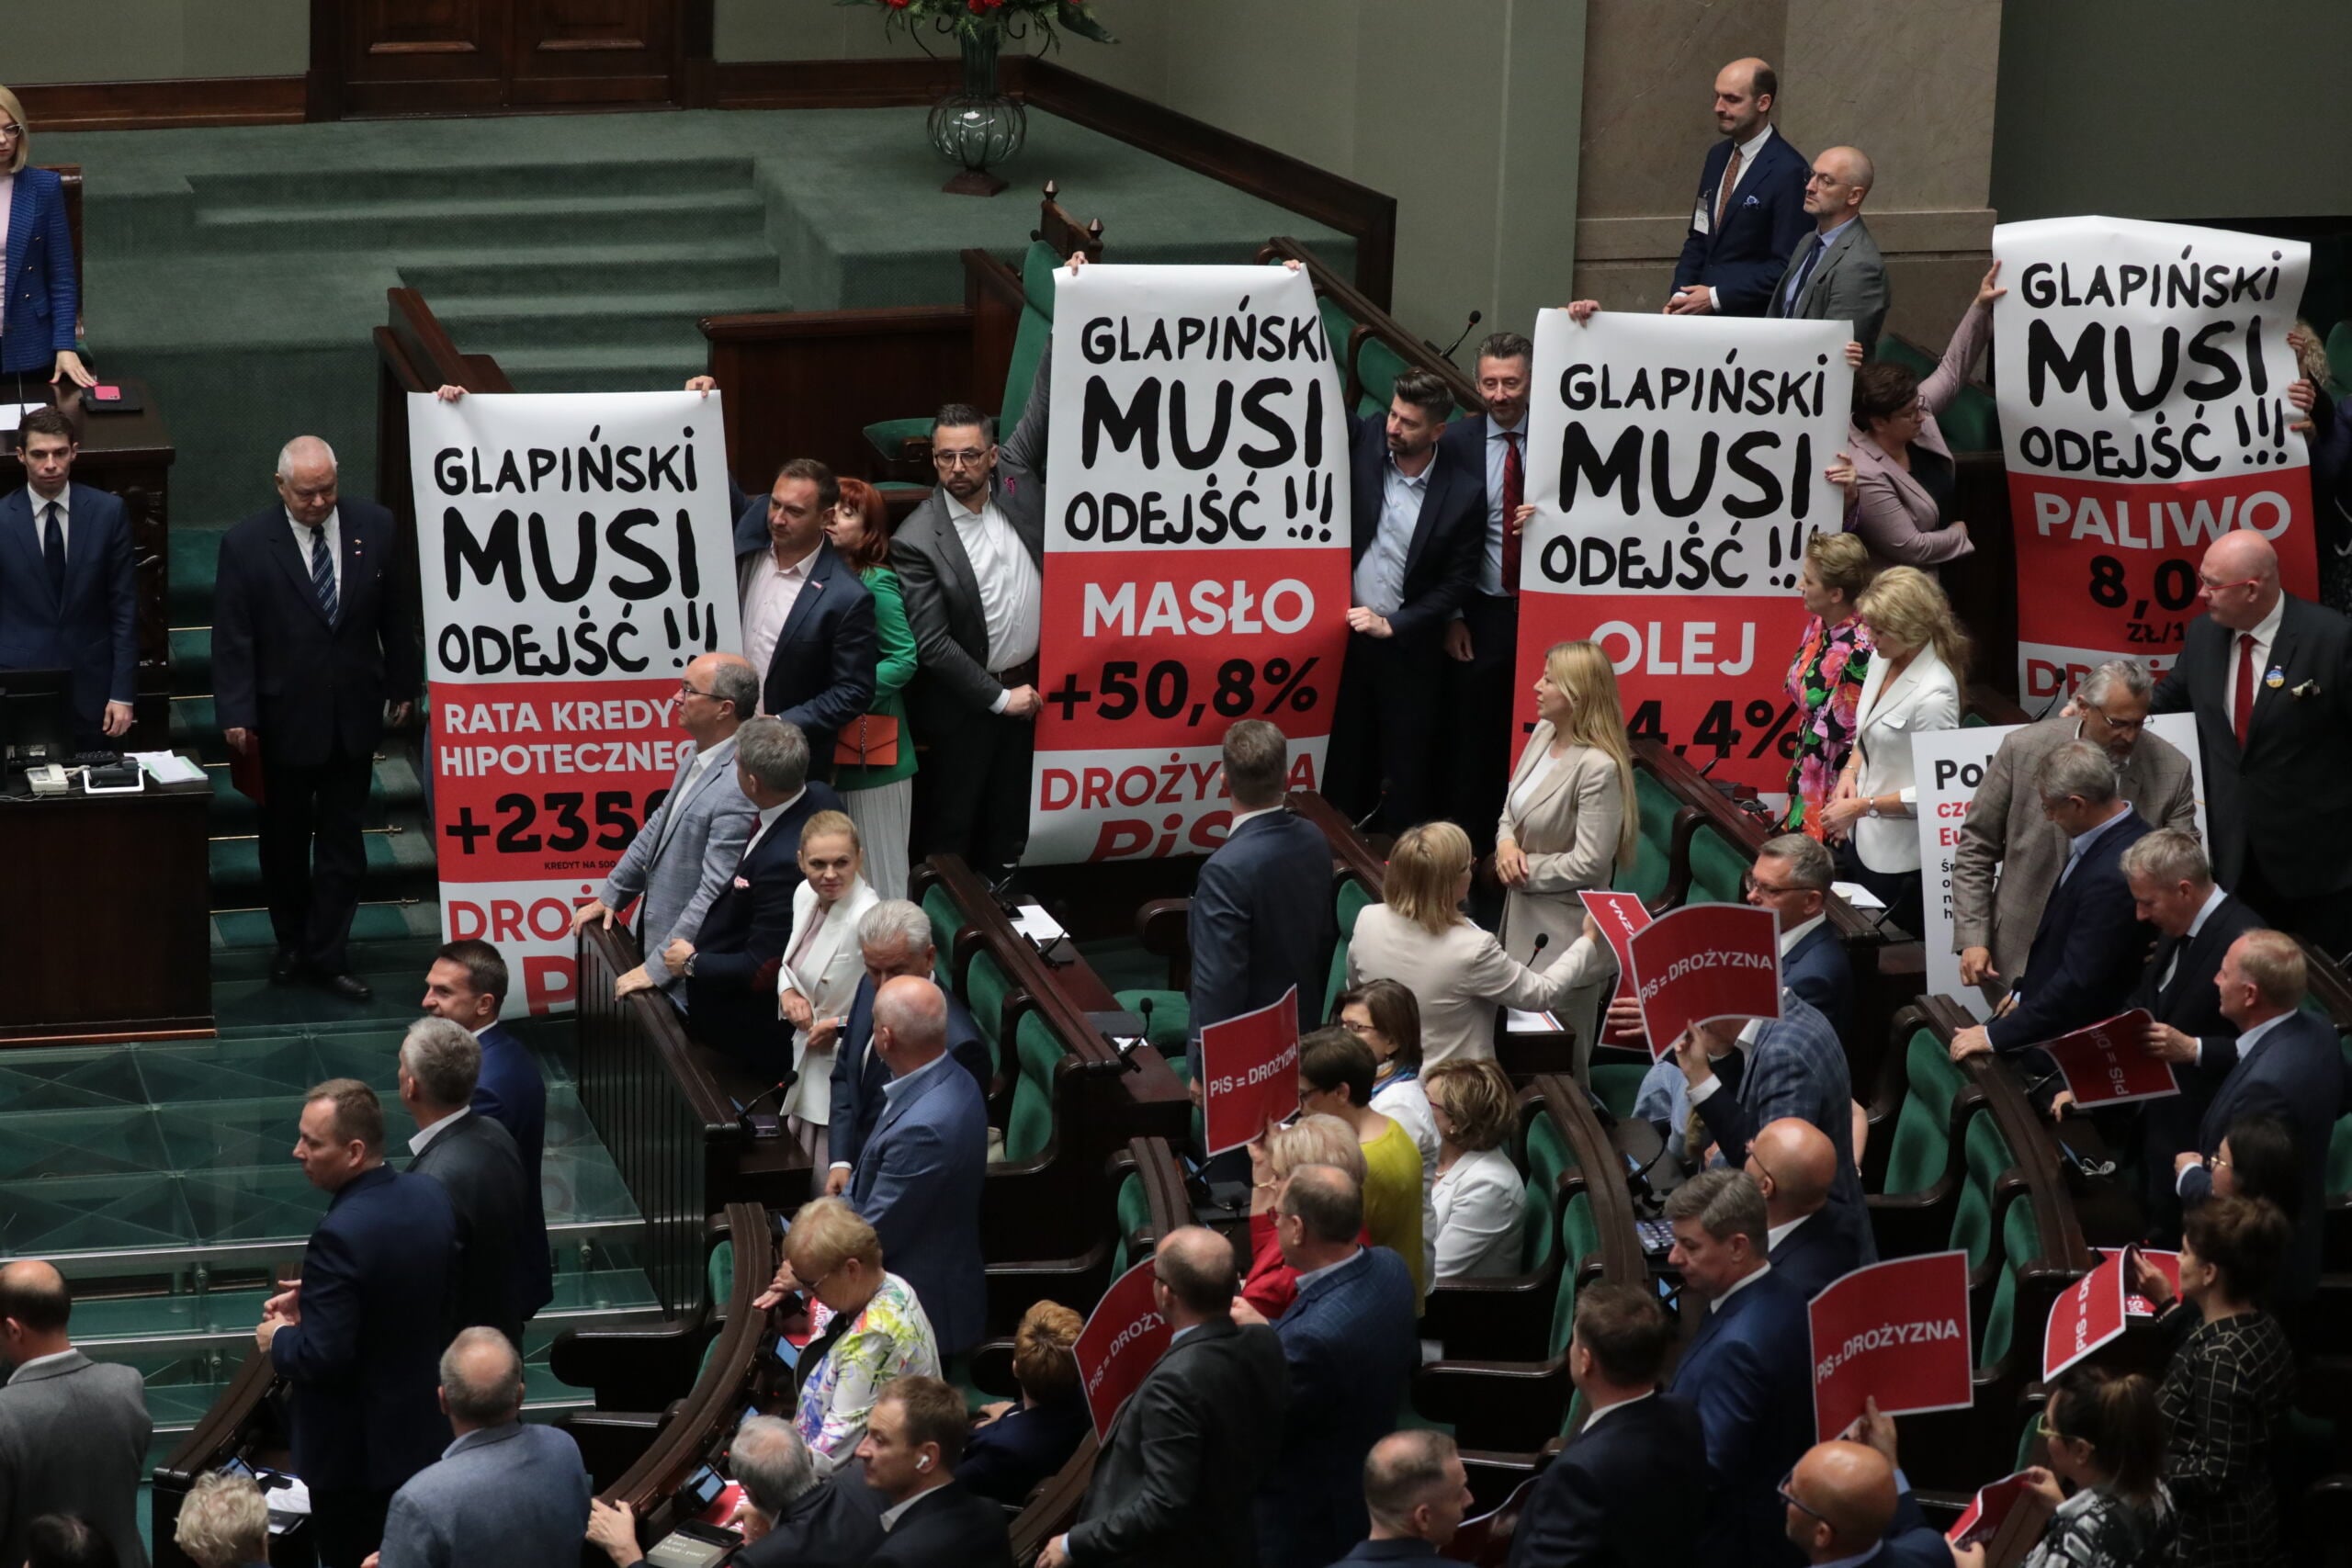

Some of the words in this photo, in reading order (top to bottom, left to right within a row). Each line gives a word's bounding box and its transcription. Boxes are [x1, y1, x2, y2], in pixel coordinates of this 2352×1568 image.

[2028, 315, 2268, 412] MUSI
[1081, 375, 1323, 470] MUSI
[2019, 403, 2221, 479] ODEJŚĆ
[1558, 420, 1812, 520] MUSI
[1064, 470, 1266, 544] ODEJŚĆ
[2033, 491, 2291, 549] PALIWO
[443, 506, 700, 603] MUSI
[1540, 520, 1748, 591] ODEJŚĆ
[1082, 578, 1315, 637] MASŁO
[2089, 555, 2197, 619] 8,0
[438, 603, 650, 676] ODEJŚĆ
[1589, 620, 1756, 676] OLEJ
[445, 703, 542, 734] RATA
[551, 699, 676, 731] KREDY
[1047, 657, 1320, 727] +50,8%
[1040, 752, 1317, 811] DROŻYA
[544, 861, 580, 870] KREDYT
[582, 861, 595, 869] NA
[1668, 948, 1773, 982] DROŻYZNA
[1210, 1076, 1233, 1098] PiS
[1237, 1077, 1246, 1087] =
[1249, 1042, 1297, 1086] DROŻYZNA
[1843, 1318, 1961, 1361] DROŻYZNA
